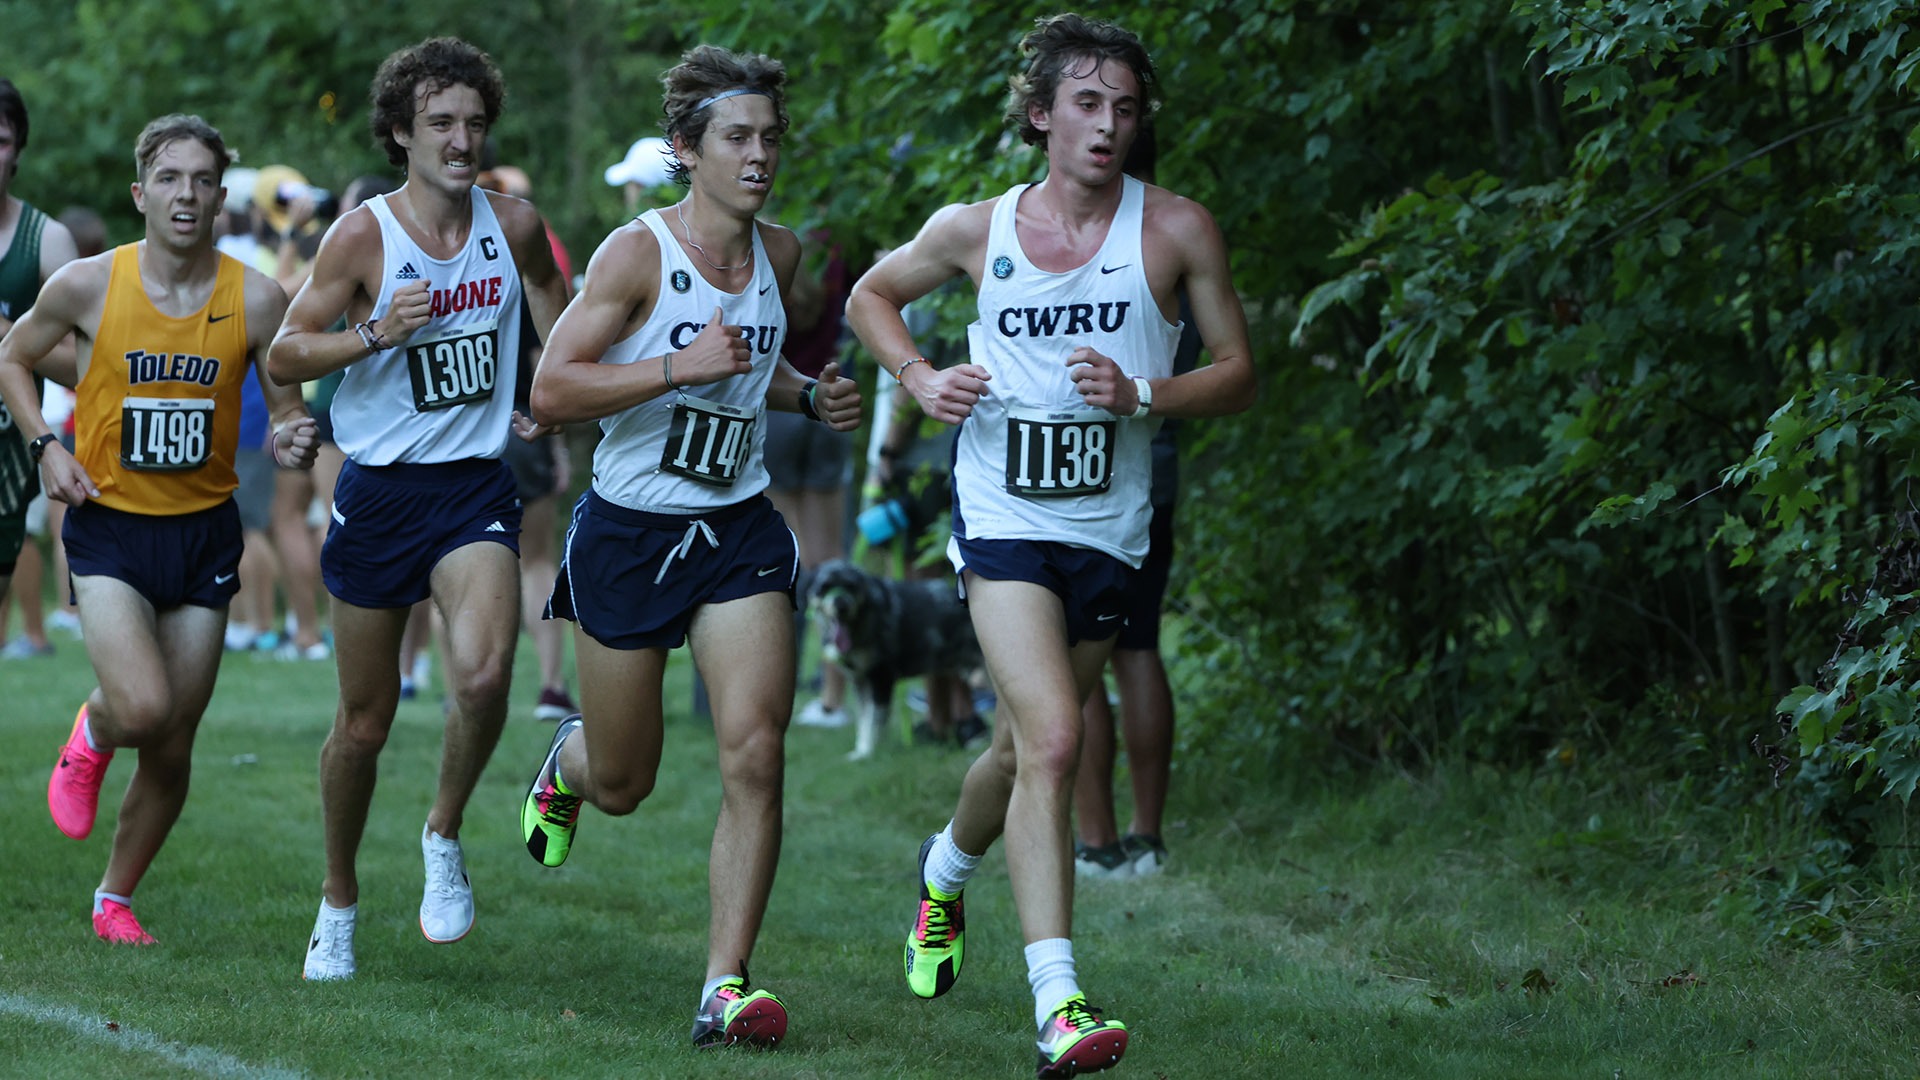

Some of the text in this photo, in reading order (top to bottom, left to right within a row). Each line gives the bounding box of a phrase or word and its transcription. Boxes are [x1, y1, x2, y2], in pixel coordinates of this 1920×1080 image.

[480, 236, 498, 261] C
[426, 276, 502, 318] ALONE
[669, 321, 778, 355] CRU
[998, 301, 1131, 338] CWRU
[124, 348, 221, 387] TOLEDO
[417, 334, 495, 402] 1308
[130, 410, 206, 465] 1498
[1016, 423, 1106, 488] 1138
